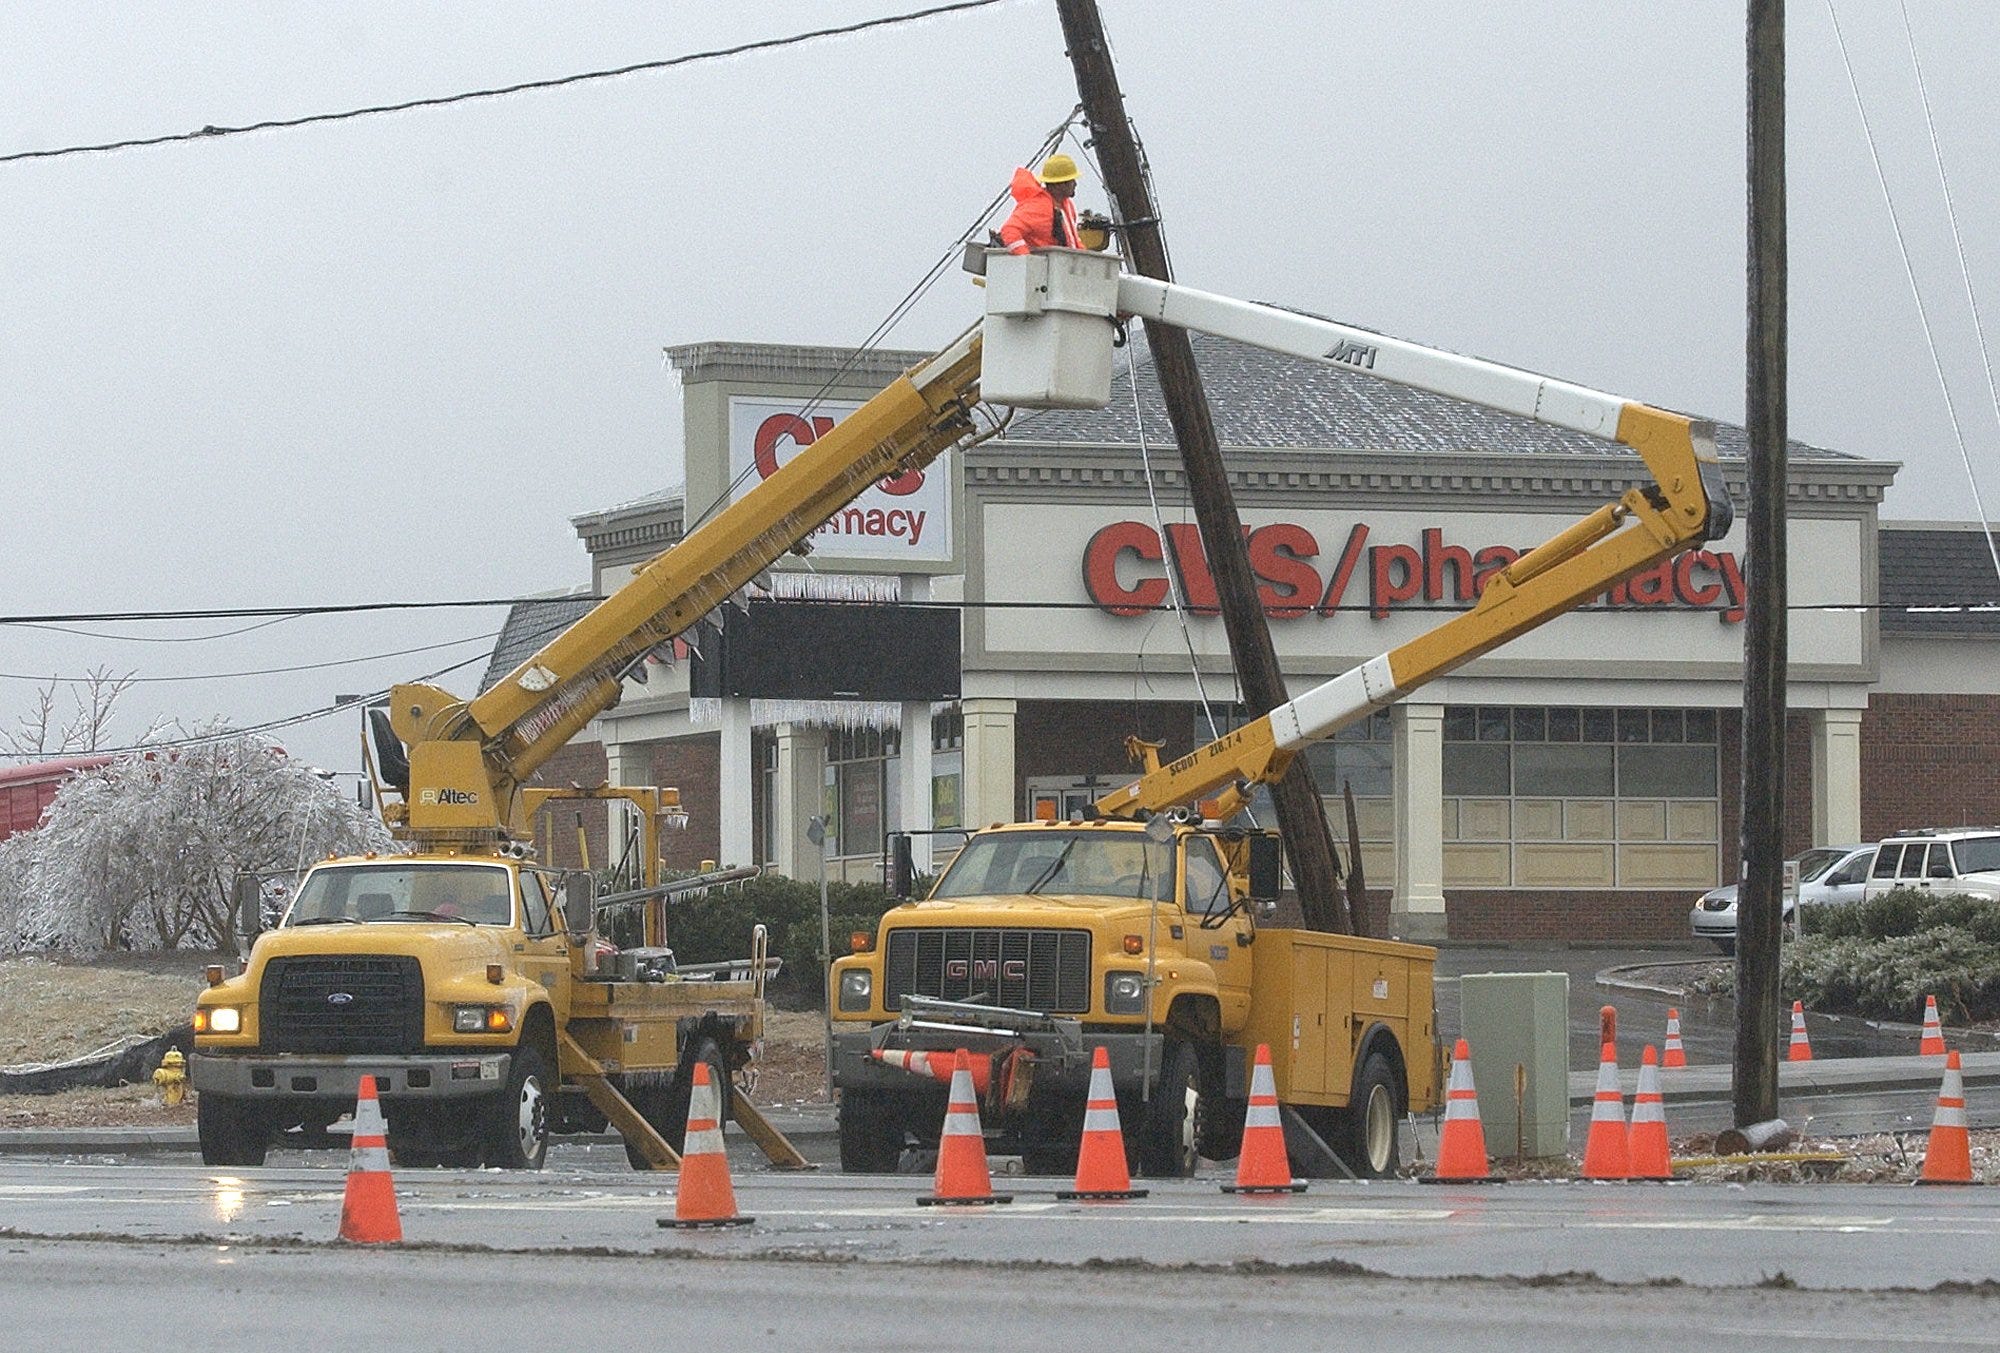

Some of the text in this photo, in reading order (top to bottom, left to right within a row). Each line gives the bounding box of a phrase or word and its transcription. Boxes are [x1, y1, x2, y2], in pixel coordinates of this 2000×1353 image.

[1323, 339, 1378, 369] MTI
[438, 788, 478, 804] Altec
[946, 959, 1025, 980] GMC
